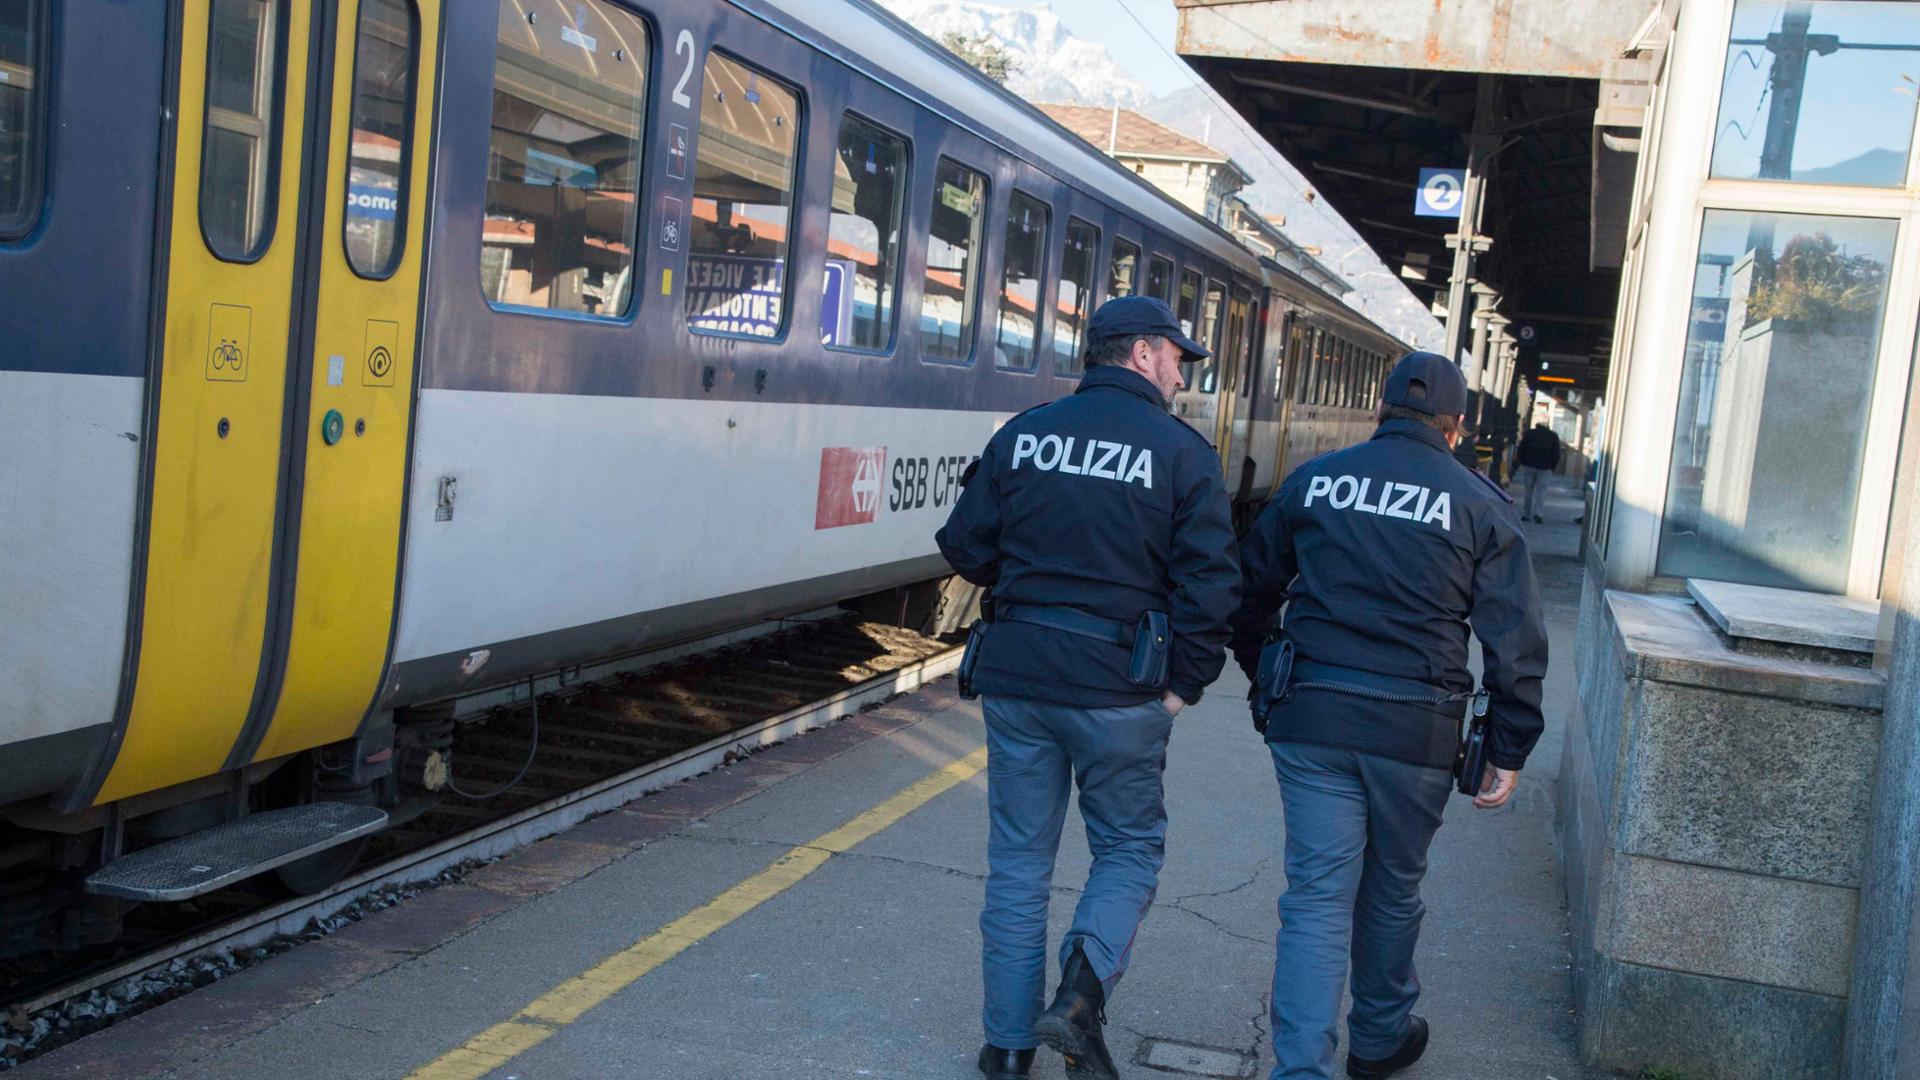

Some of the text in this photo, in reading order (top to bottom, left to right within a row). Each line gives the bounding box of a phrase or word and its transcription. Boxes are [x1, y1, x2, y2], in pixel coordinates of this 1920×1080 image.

[672, 29, 695, 109] 2
[1434, 180, 1452, 203] 2
[890, 456, 929, 512] SBB
[1011, 433, 1152, 489] POLIZIA
[1304, 475, 1450, 531] POLIZIA
